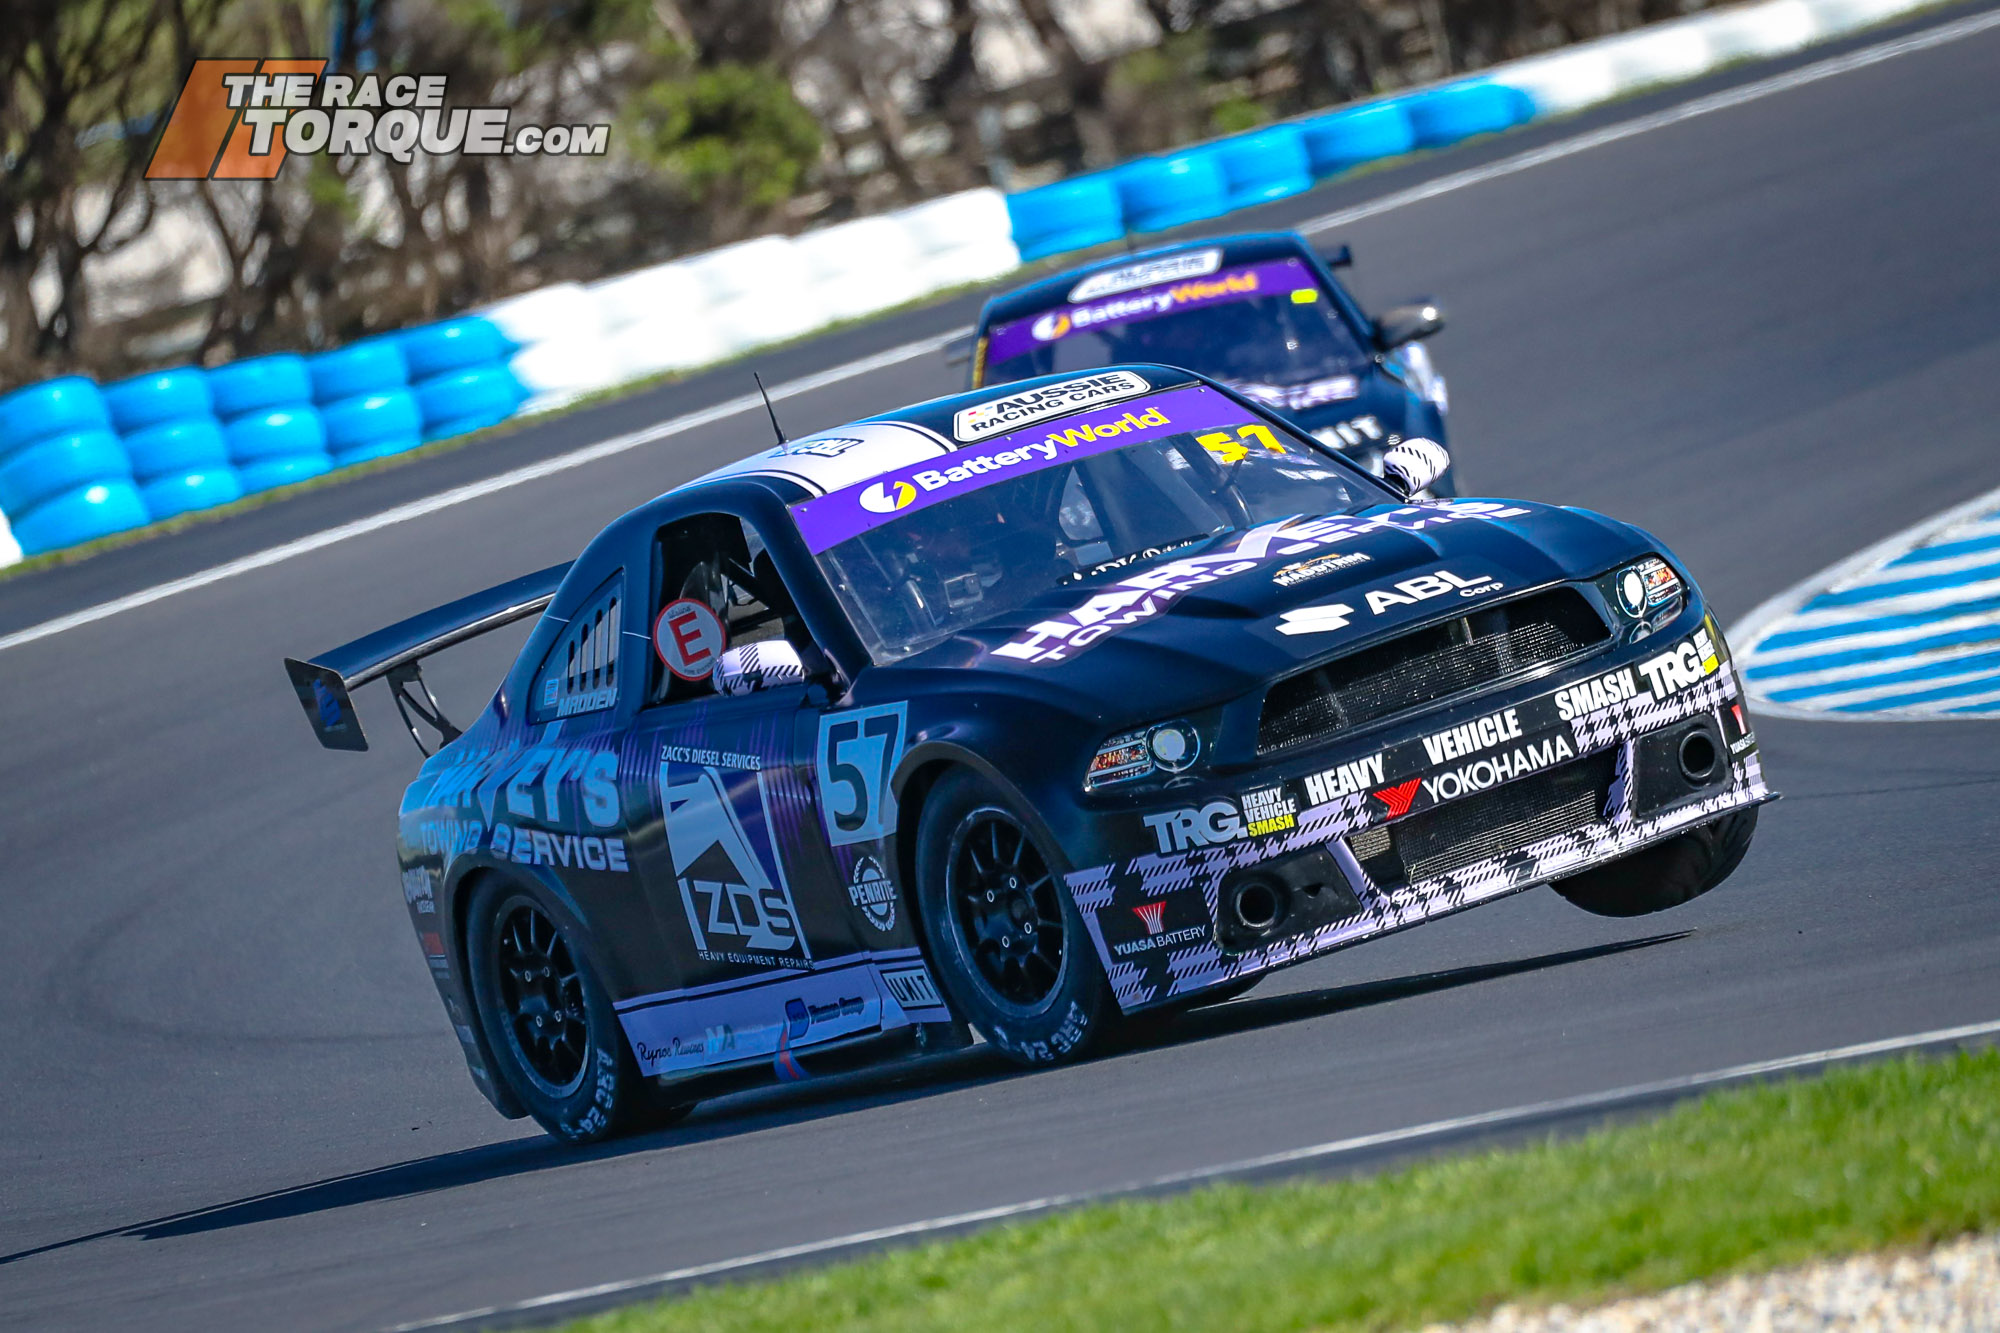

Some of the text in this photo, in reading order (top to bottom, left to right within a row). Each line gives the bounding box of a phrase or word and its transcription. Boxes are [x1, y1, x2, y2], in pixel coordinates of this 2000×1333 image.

[970, 382, 1136, 432] RACING CARS
[996, 374, 1126, 414] AUSSIE
[912, 407, 1170, 492] BatteryWorld
[1196, 424, 1287, 463] 57
[1365, 570, 1493, 616] ABL
[1459, 581, 1504, 598] Corp
[1030, 561, 1257, 663] TOWING
[669, 611, 712, 667] E
[557, 687, 619, 718] MADDEN
[1554, 668, 1637, 721] SMASH
[661, 745, 761, 771] ZACC'S DIESEL SERVICES
[1422, 709, 1523, 765] VEHICLE
[827, 713, 899, 832] 57
[1304, 753, 1386, 806] HEAVY
[1422, 734, 1574, 803] YOKOHAMA
[1241, 786, 1282, 810] HEAVY
[1243, 798, 1297, 823] VEHICLE
[490, 822, 629, 872] SERVICE
[1247, 814, 1295, 837] SMASH
[693, 879, 796, 950] ZDS
[848, 880, 897, 906] PENRITE
[699, 951, 815, 971] HEAVY EQUIPMENT REPAIRS
[1114, 924, 1206, 956] YUASA BATTERY
[888, 975, 934, 1001] UNIT
